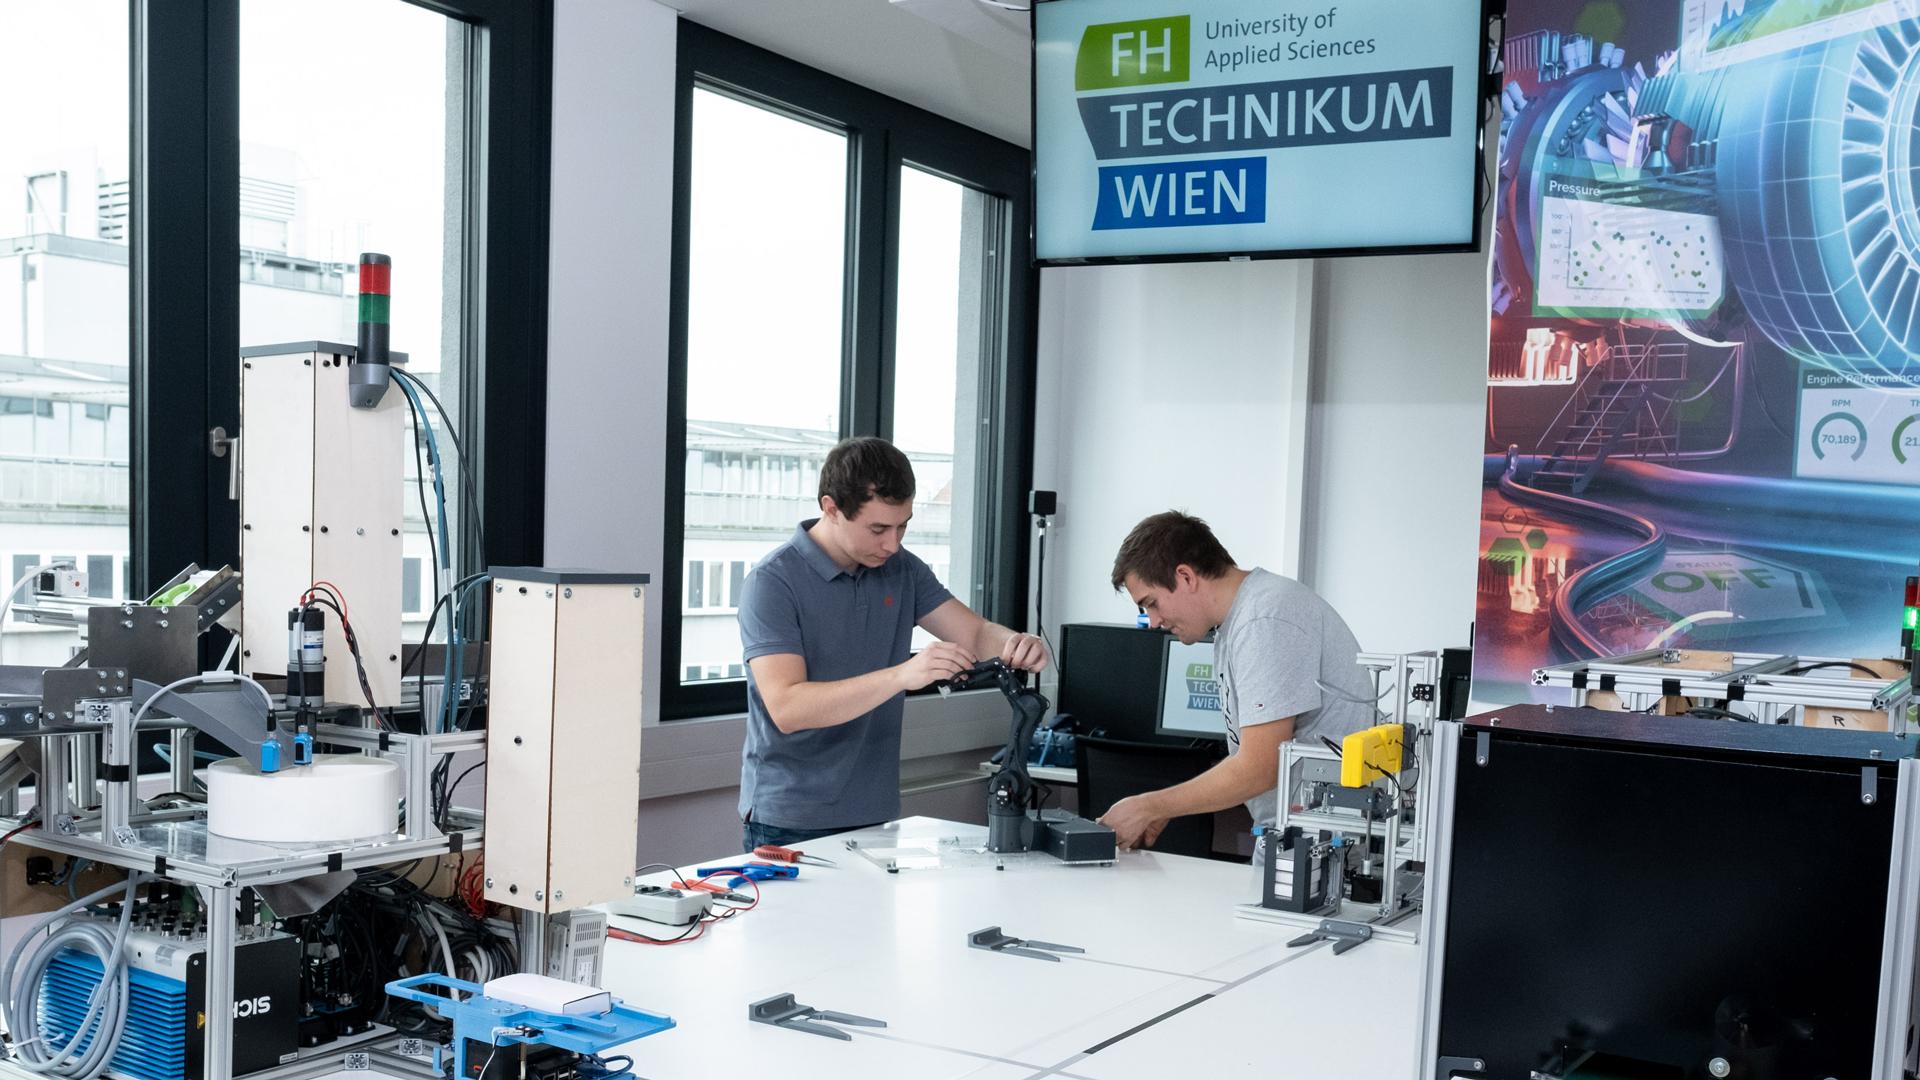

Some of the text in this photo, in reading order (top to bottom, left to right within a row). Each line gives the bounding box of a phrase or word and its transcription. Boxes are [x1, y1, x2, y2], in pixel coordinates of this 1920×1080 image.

[1206, 8, 1337, 40] University of
[1111, 27, 1171, 77] FH
[1204, 37, 1376, 72] Applied Sciences
[1109, 79, 1434, 148] TECHNIKUM
[1114, 168, 1247, 219] WIEN
[1550, 180, 1600, 196] Pressure
[1807, 374, 1843, 385] Engine
[1831, 399, 1851, 407] RPM
[1822, 434, 1857, 445] 70,189
[1651, 568, 1777, 593] OFF
[1193, 665, 1209, 677] FH
[1193, 681, 1220, 693] TECH
